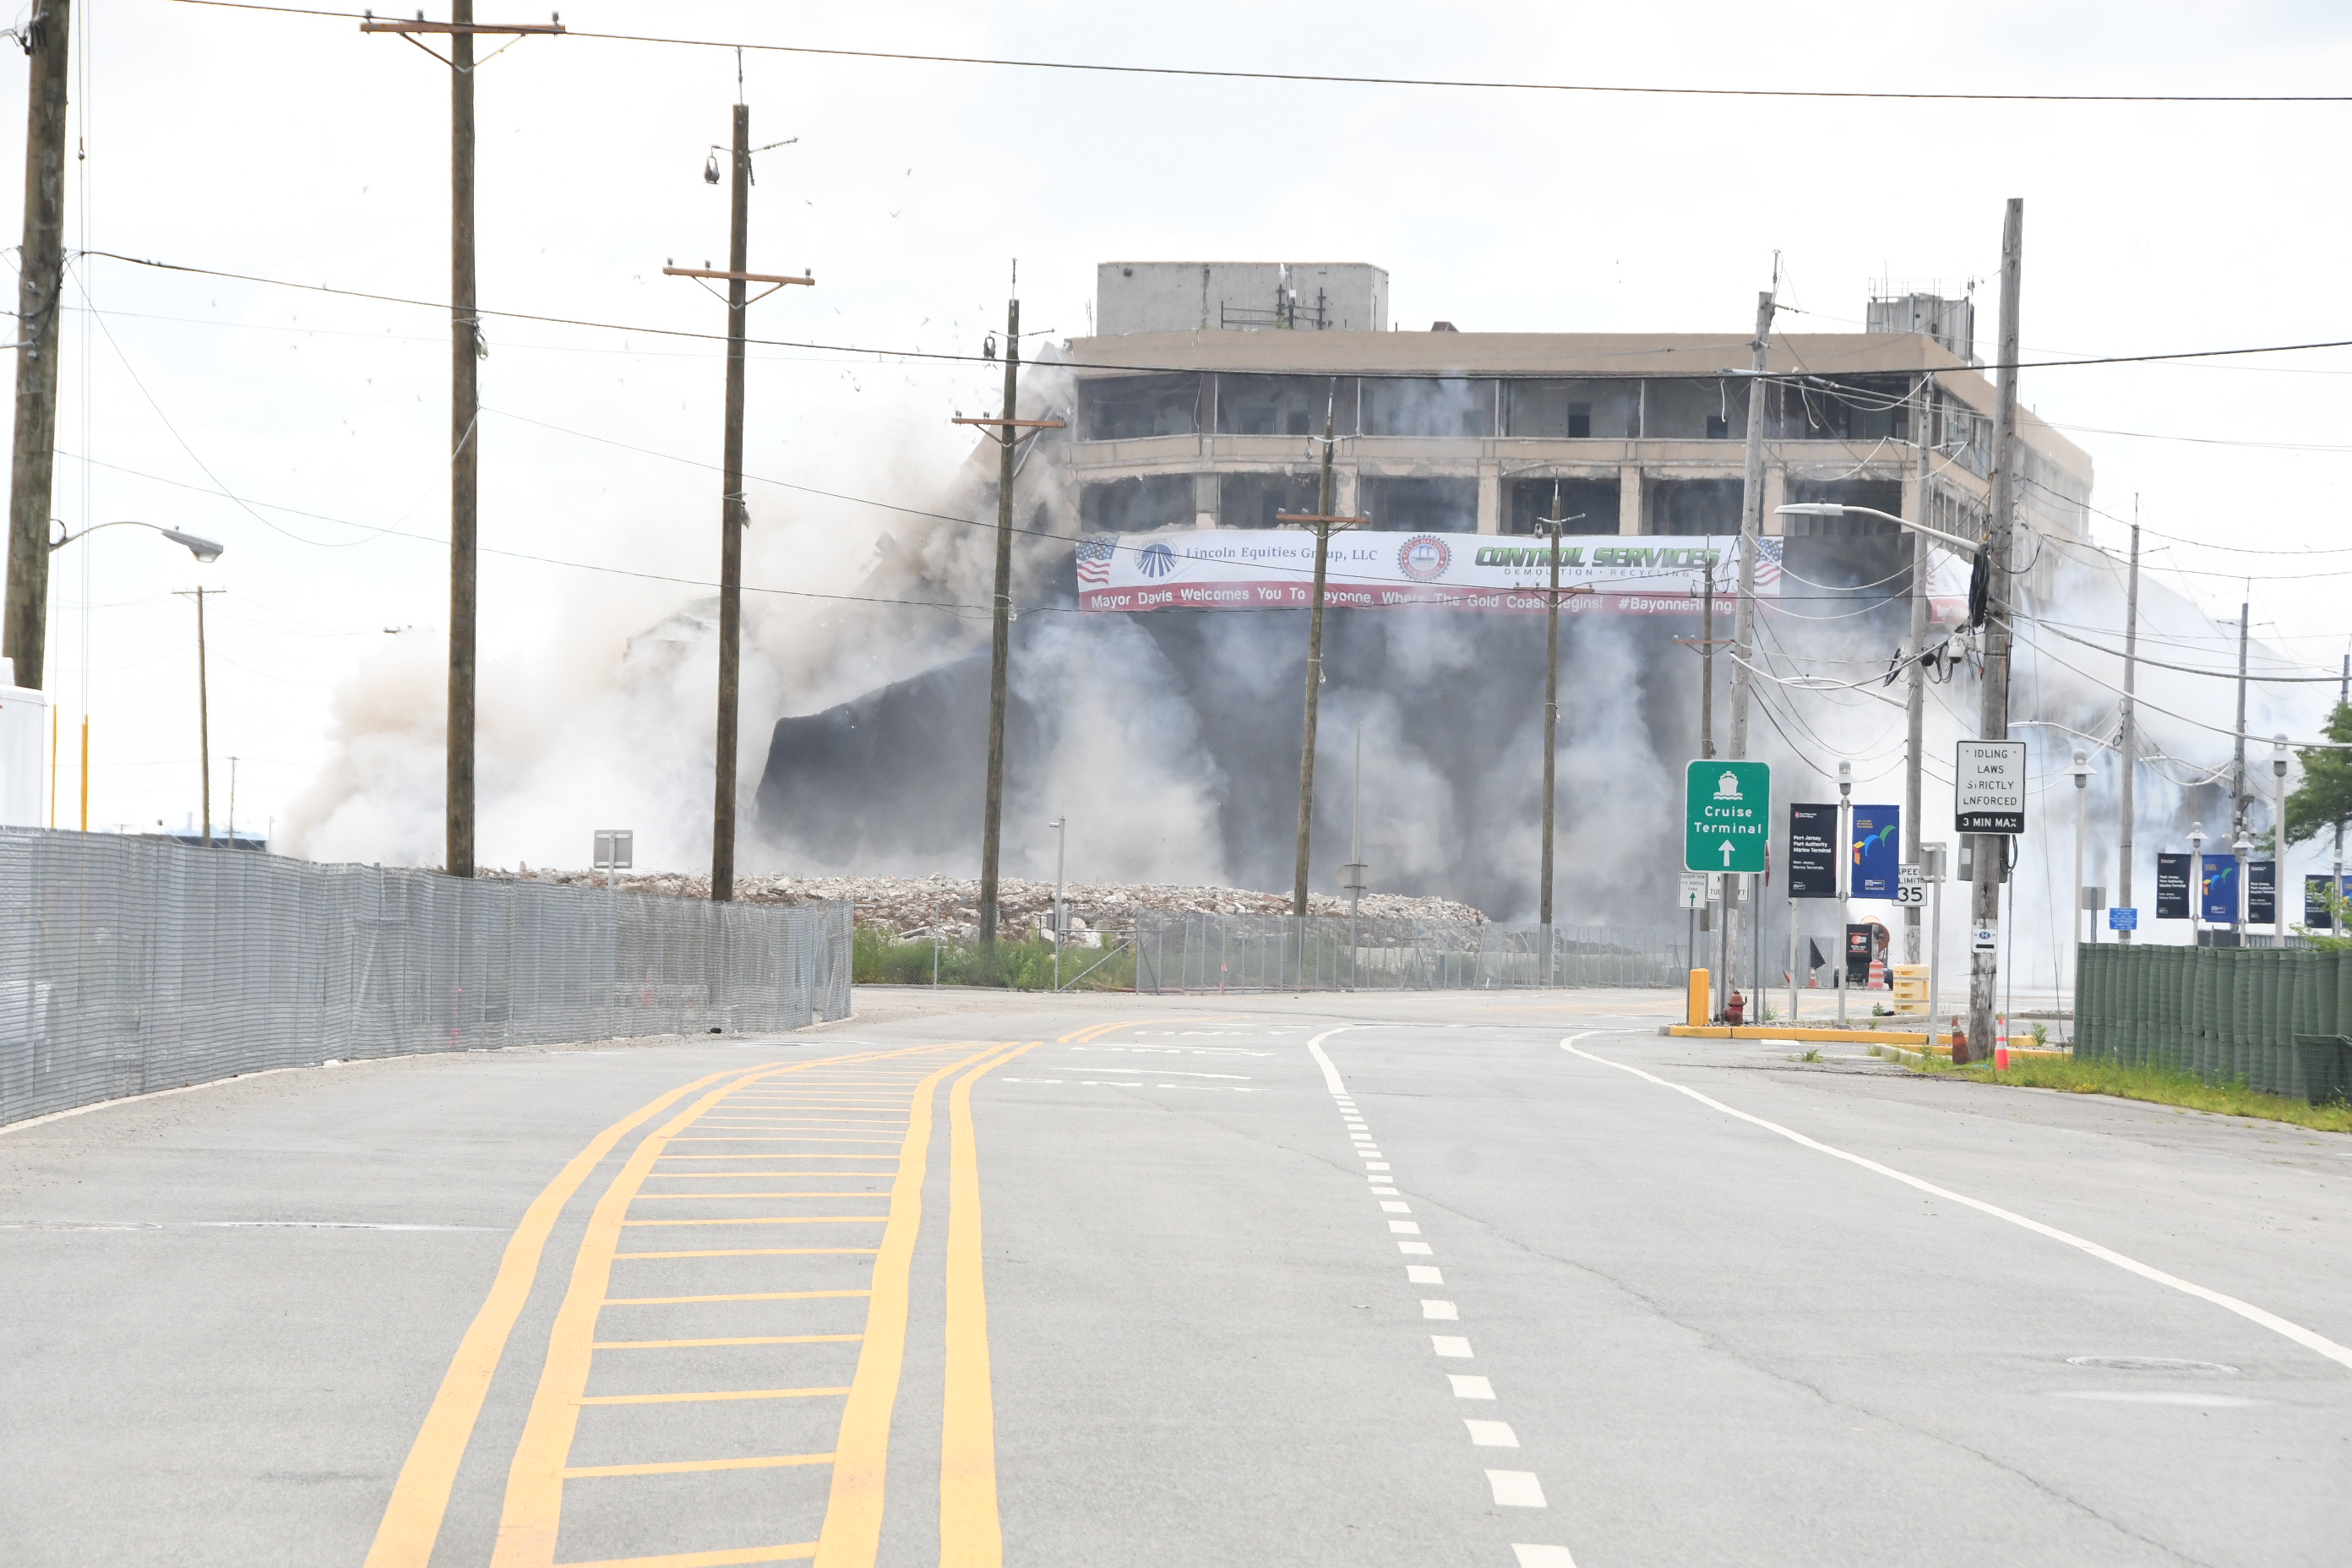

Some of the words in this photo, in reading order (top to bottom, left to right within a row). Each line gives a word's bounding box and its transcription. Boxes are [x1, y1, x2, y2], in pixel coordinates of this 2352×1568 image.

[1186, 547, 1236, 558] Lincoln
[1241, 547, 1297, 560] Equities
[1301, 548, 1347, 562] Grup,
[1352, 549, 1378, 560] LLC
[1474, 547, 1586, 567] CONTROL
[1592, 547, 1721, 568] SERVICES
[1610, 569, 1690, 577] RECYCLING
[1091, 595, 1131, 608] Mayor
[1138, 591, 1173, 605] Davis
[1180, 587, 1250, 601] Welcomes
[1257, 587, 1282, 600] You
[1289, 587, 1305, 600] To
[1323, 591, 1374, 605] ayonne,
[1434, 592, 1460, 606] The
[1467, 594, 1500, 607] Gold
[1506, 595, 1545, 608] Coast
[1618, 596, 1735, 613] #BayonneRiing.
[1974, 749, 2008, 759] IDLING
[1977, 765, 2004, 774] LAWS
[1704, 805, 1752, 817] Cruise
[1694, 821, 1761, 834] Terminal
[1973, 817, 1991, 827] MIN
[1995, 818, 2017, 827] MAX
[1897, 886, 1923, 902] 35
